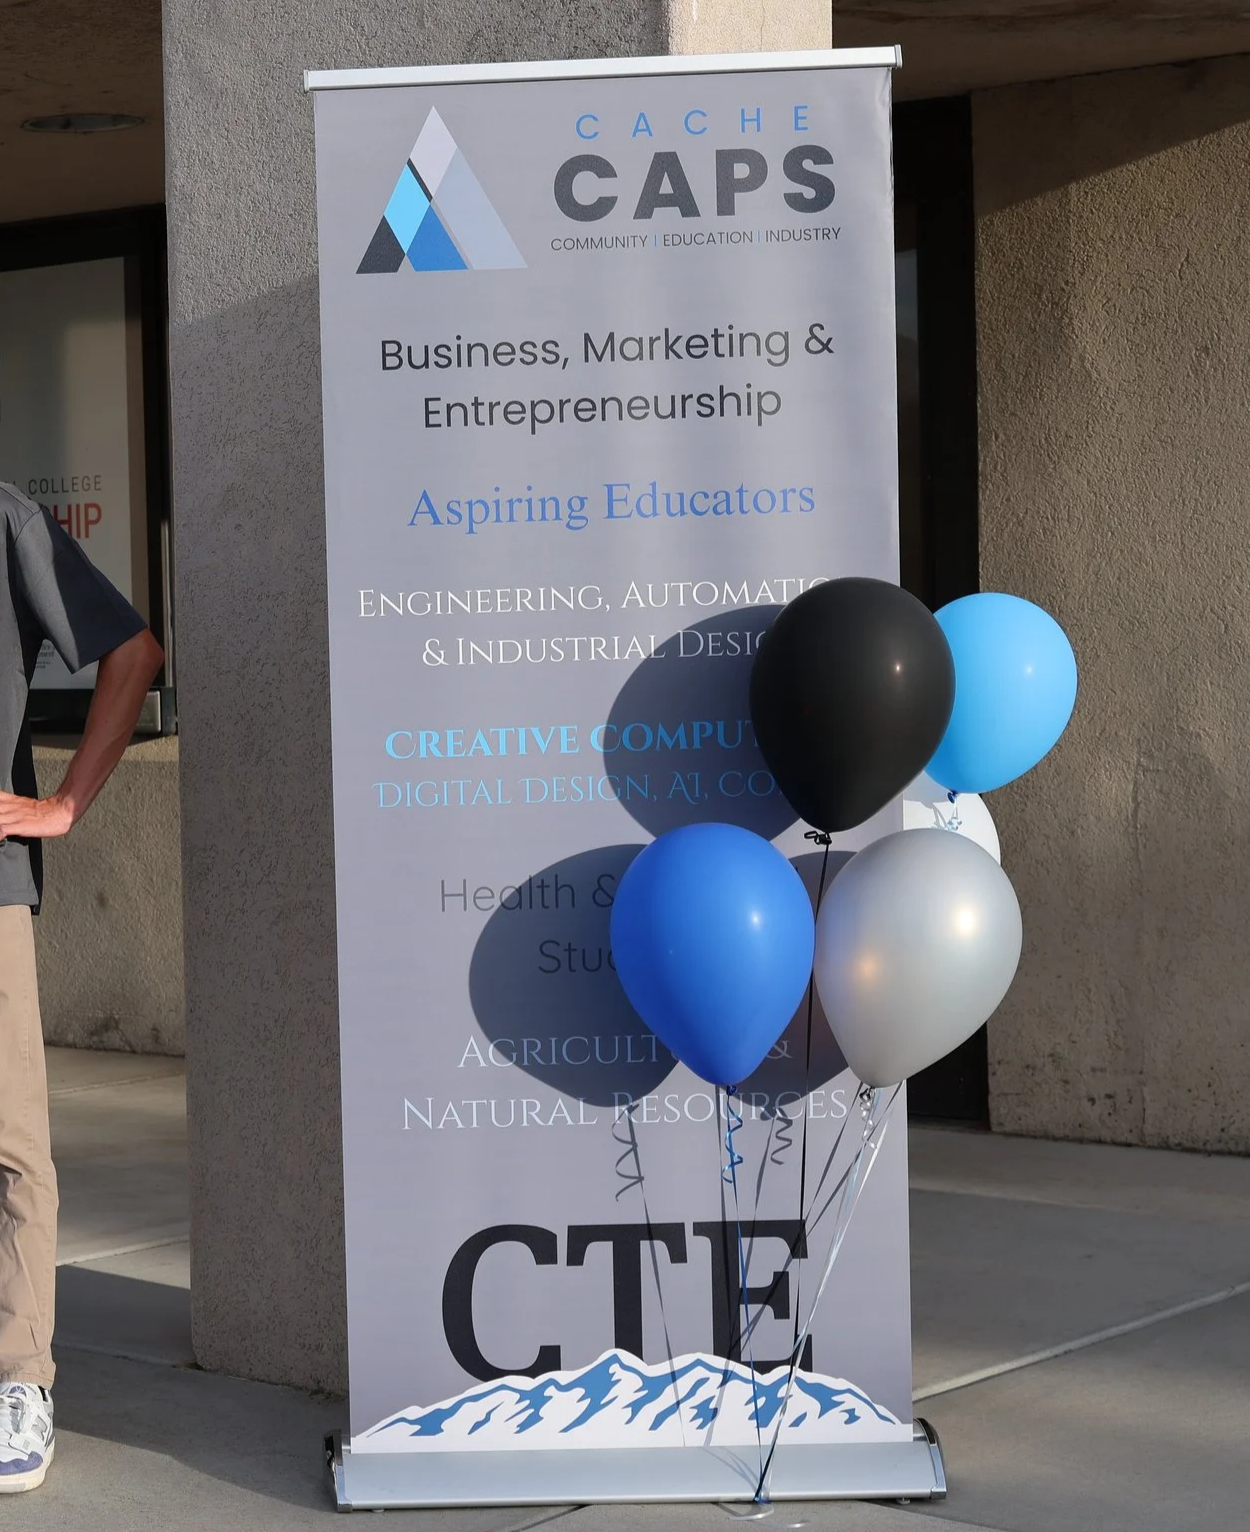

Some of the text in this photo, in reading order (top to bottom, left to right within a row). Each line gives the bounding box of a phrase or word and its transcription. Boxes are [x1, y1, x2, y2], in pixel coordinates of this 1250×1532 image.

[575, 104, 809, 140] CACHE
[553, 145, 835, 222] CAPS
[551, 227, 841, 251] COMMUNITY EDUCATION INDUSTRY
[381, 322, 835, 372] Business, Marketing &
[424, 382, 782, 435] Entrepreneurship
[28, 475, 102, 495] COLLEGE
[407, 481, 816, 535] Aspiring Educators
[358, 576, 840, 618] ENGINEERING, AUTOMATI
[422, 638, 449, 667] &
[457, 633, 666, 665] INDUSTRIAL
[385, 725, 580, 760] CREATIVE
[371, 778, 513, 809] DIGITAL
[518, 773, 656, 805] DESIGN,
[718, 771, 782, 798] CO
[440, 873, 615, 913] Health &
[457, 1034, 681, 1069] AGRICULT
[401, 1088, 847, 1131] NATURAL RESOURCES
[442, 1219, 813, 1383] CTE
